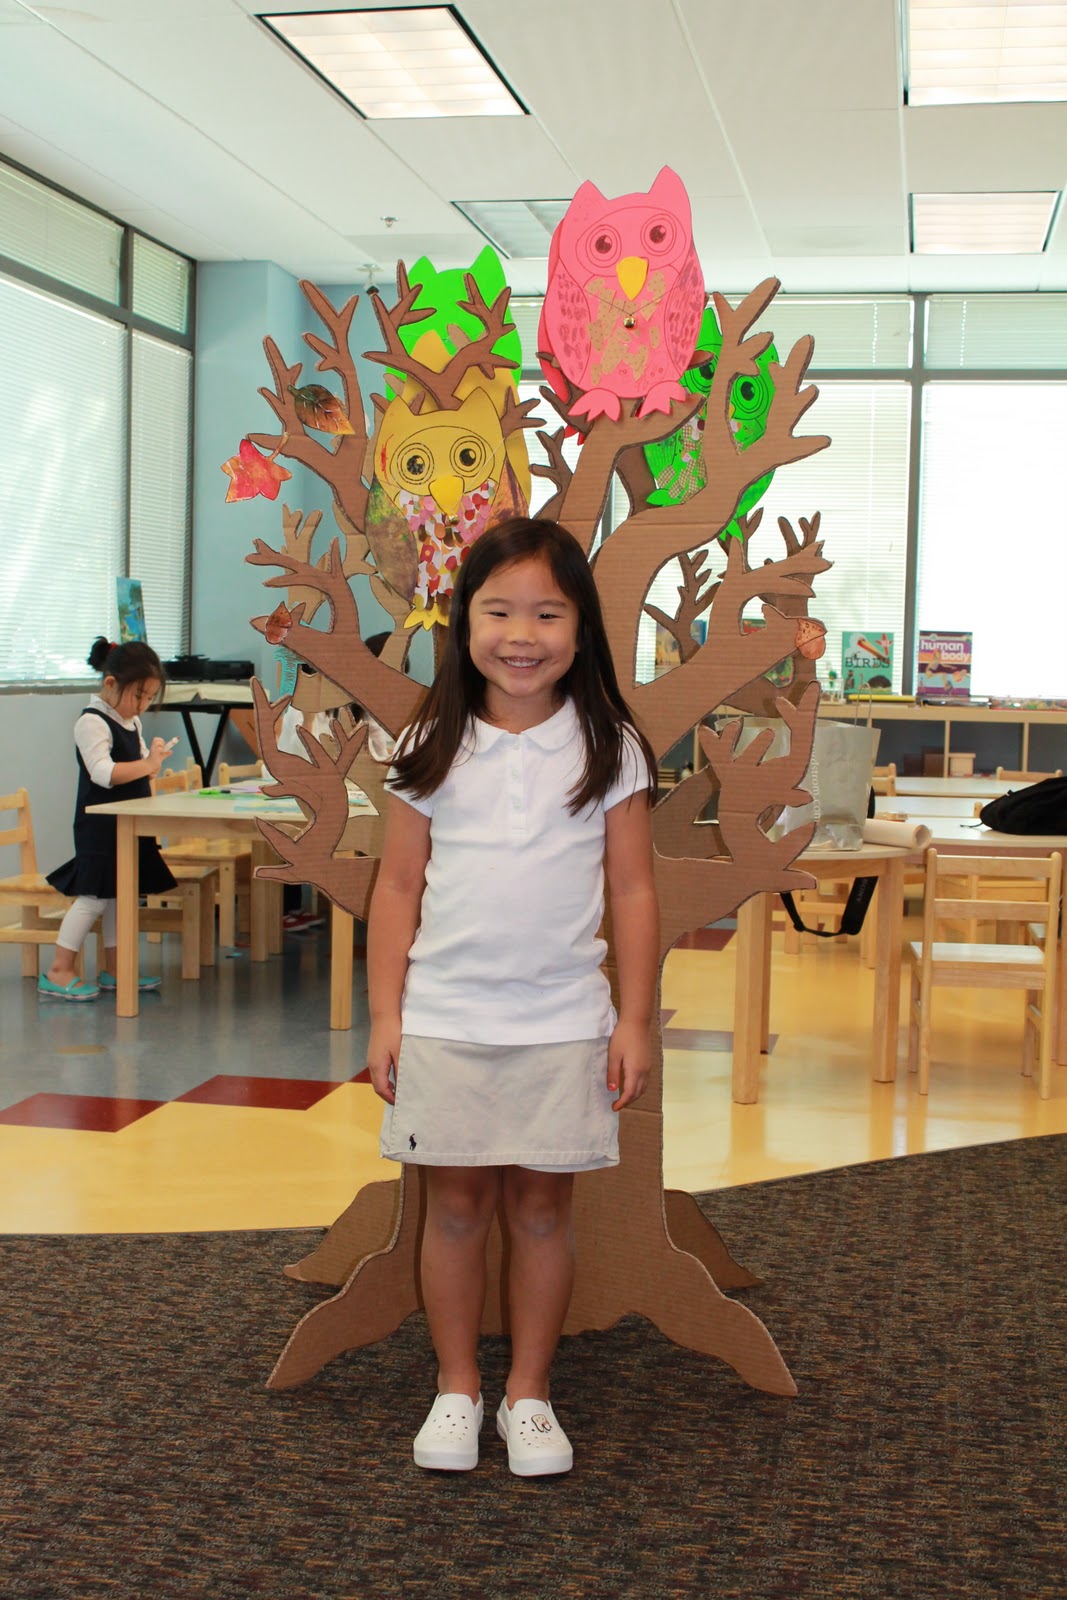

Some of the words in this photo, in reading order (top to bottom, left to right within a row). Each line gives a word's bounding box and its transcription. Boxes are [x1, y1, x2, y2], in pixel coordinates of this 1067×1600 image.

[921, 639, 964, 651] human
[942, 650, 970, 662] body
[845, 657, 890, 668] BIRDS
